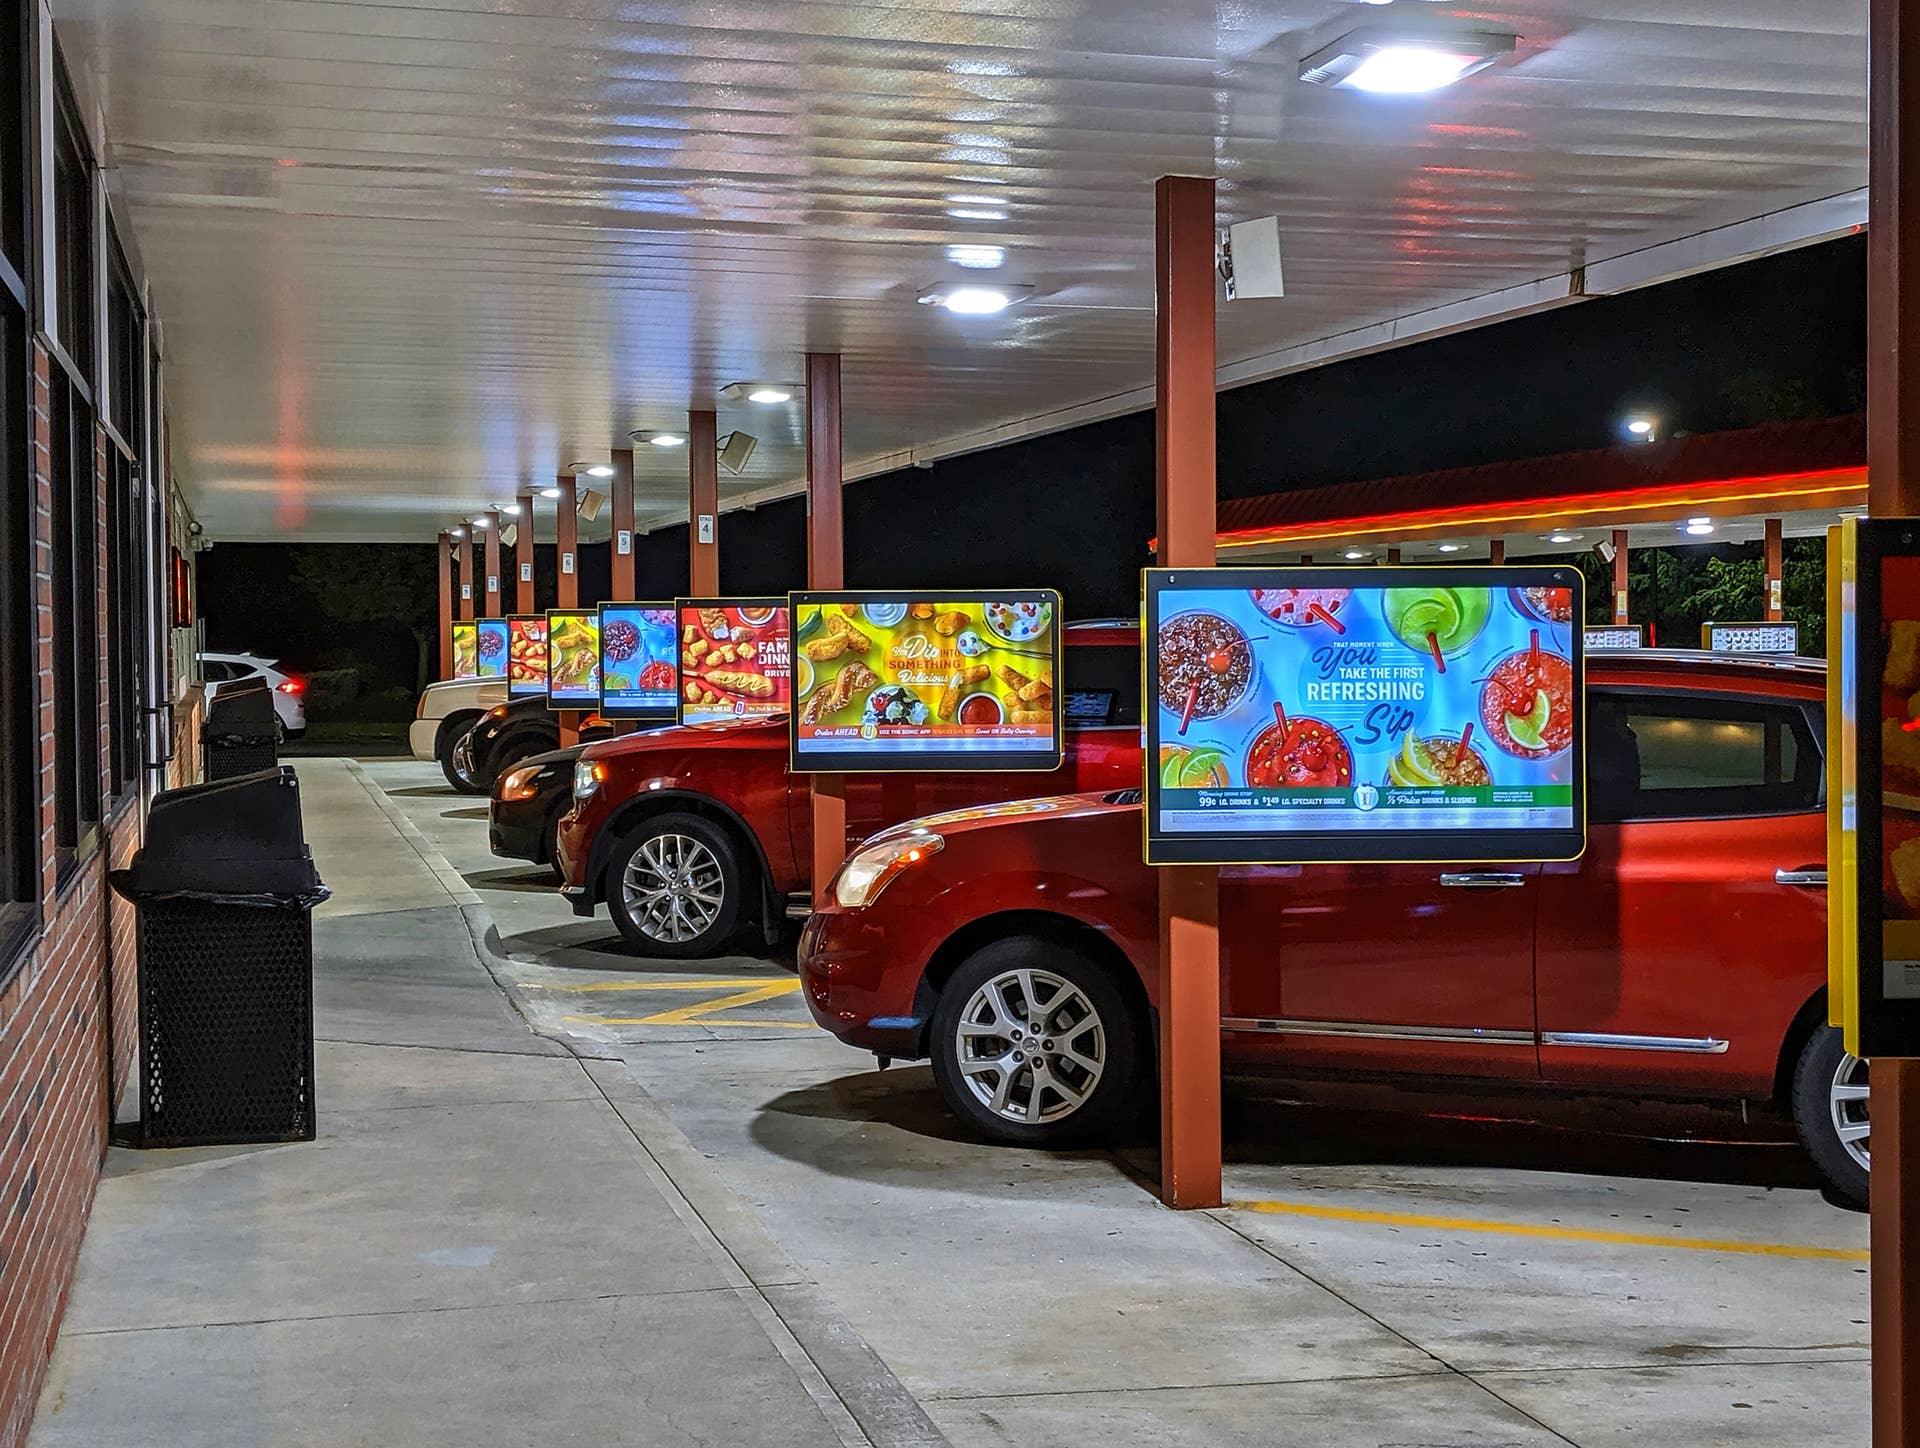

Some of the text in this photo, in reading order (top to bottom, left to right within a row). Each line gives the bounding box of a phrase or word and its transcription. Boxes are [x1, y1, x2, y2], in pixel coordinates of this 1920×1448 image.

[702, 523, 711, 533] 4
[621, 537, 627, 546] 5
[903, 634, 940, 660] Dip
[889, 660, 961, 669] SOMETHING
[1311, 646, 1377, 680] You
[897, 669, 949, 683] Delicious
[1339, 667, 1425, 679] TAKE THE FIRST
[1306, 681, 1425, 701] REFRESHING
[1354, 702, 1415, 745] Sip
[814, 728, 834, 736] Order
[834, 728, 859, 736] AHEAD
[1396, 795, 1421, 805] Price
